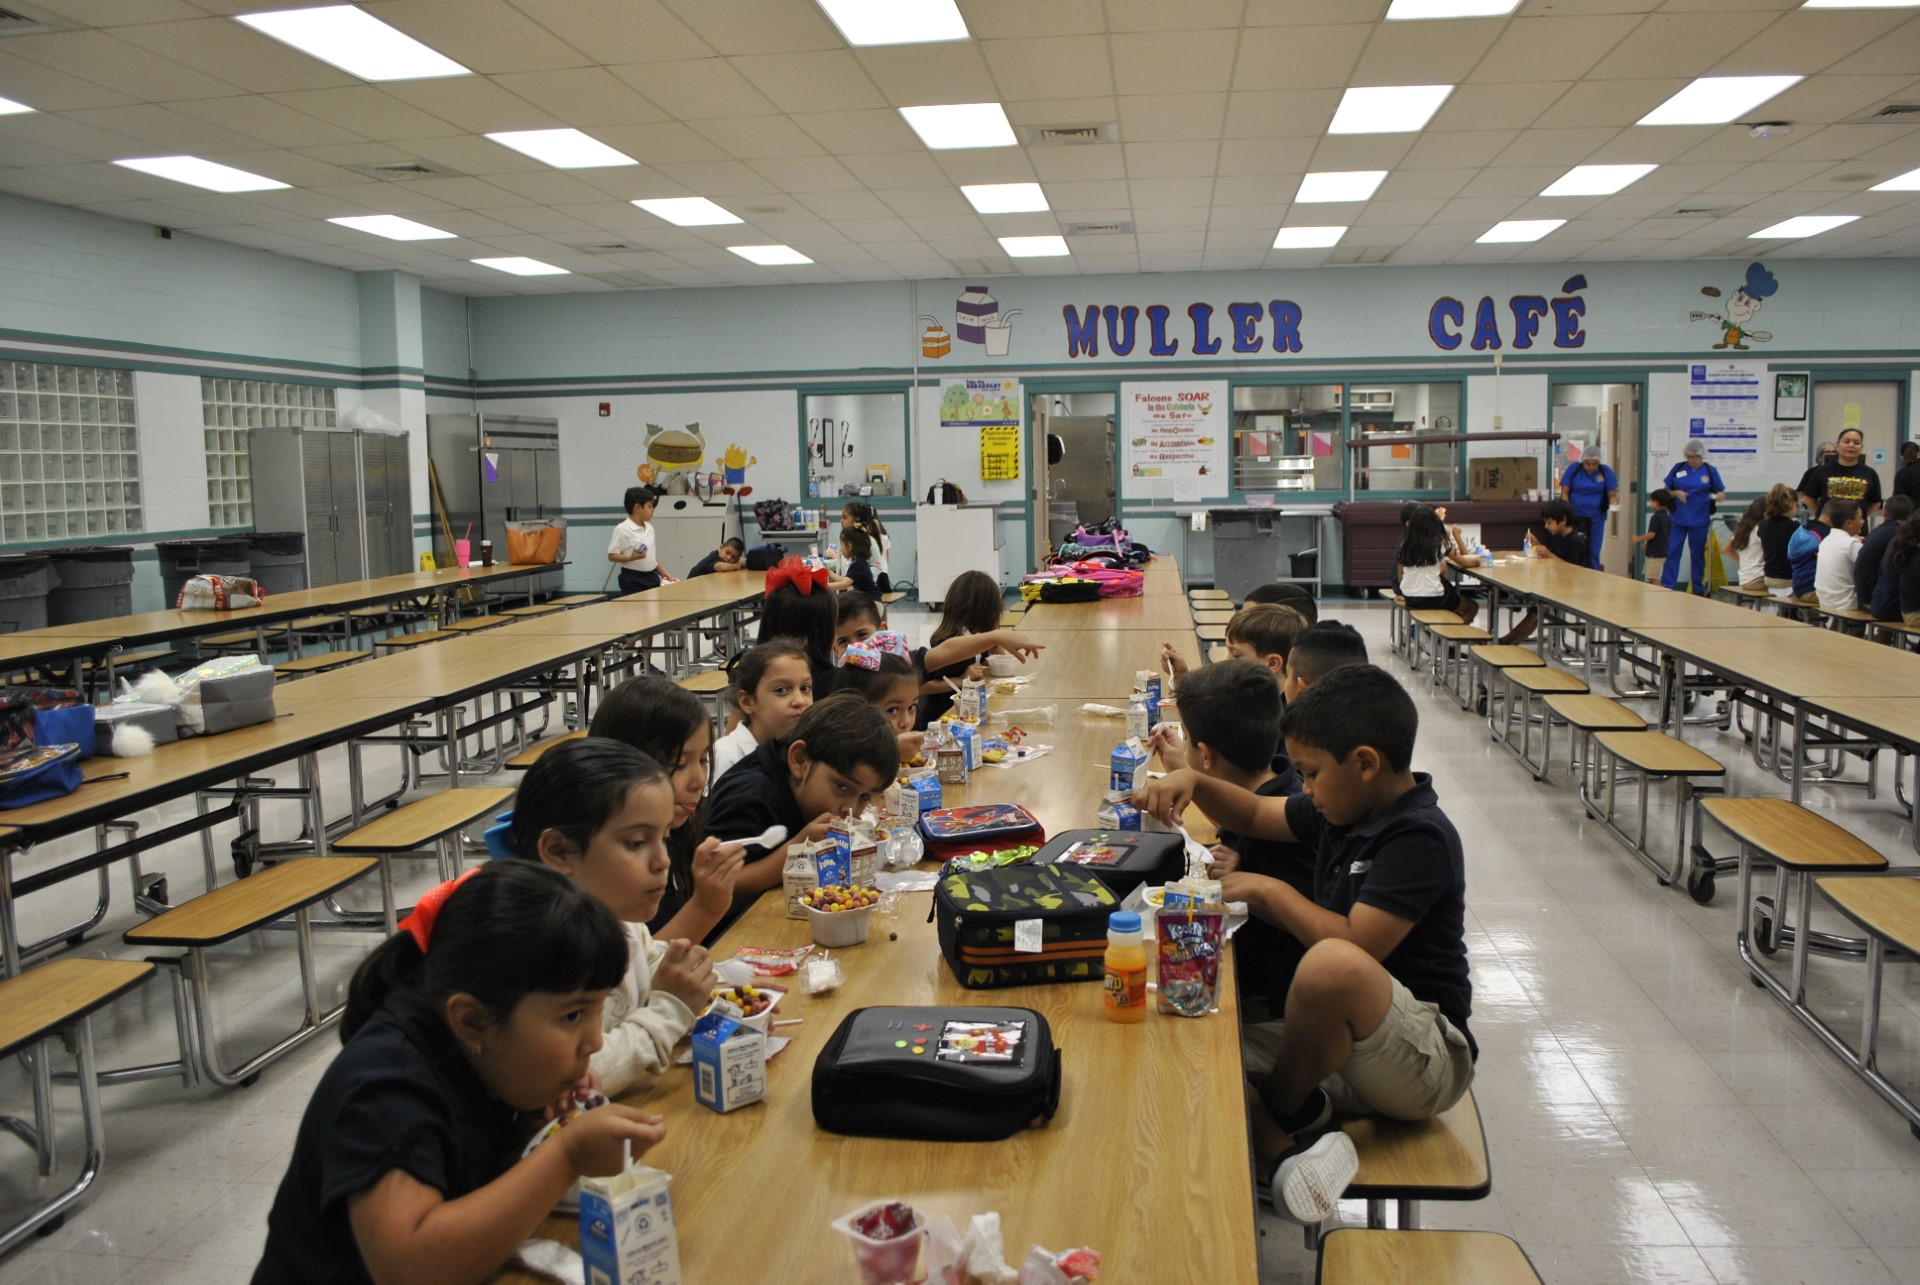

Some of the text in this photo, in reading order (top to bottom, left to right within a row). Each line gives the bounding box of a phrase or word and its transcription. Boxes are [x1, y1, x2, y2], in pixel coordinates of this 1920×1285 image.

[1062, 273, 1589, 359] MULLER CAFÉ
[1135, 392, 1210, 402] Falcons SOAR
[1155, 403, 1165, 411] the
[1159, 440, 1195, 448] Accountable
[1488, 467, 1500, 489] Trix
